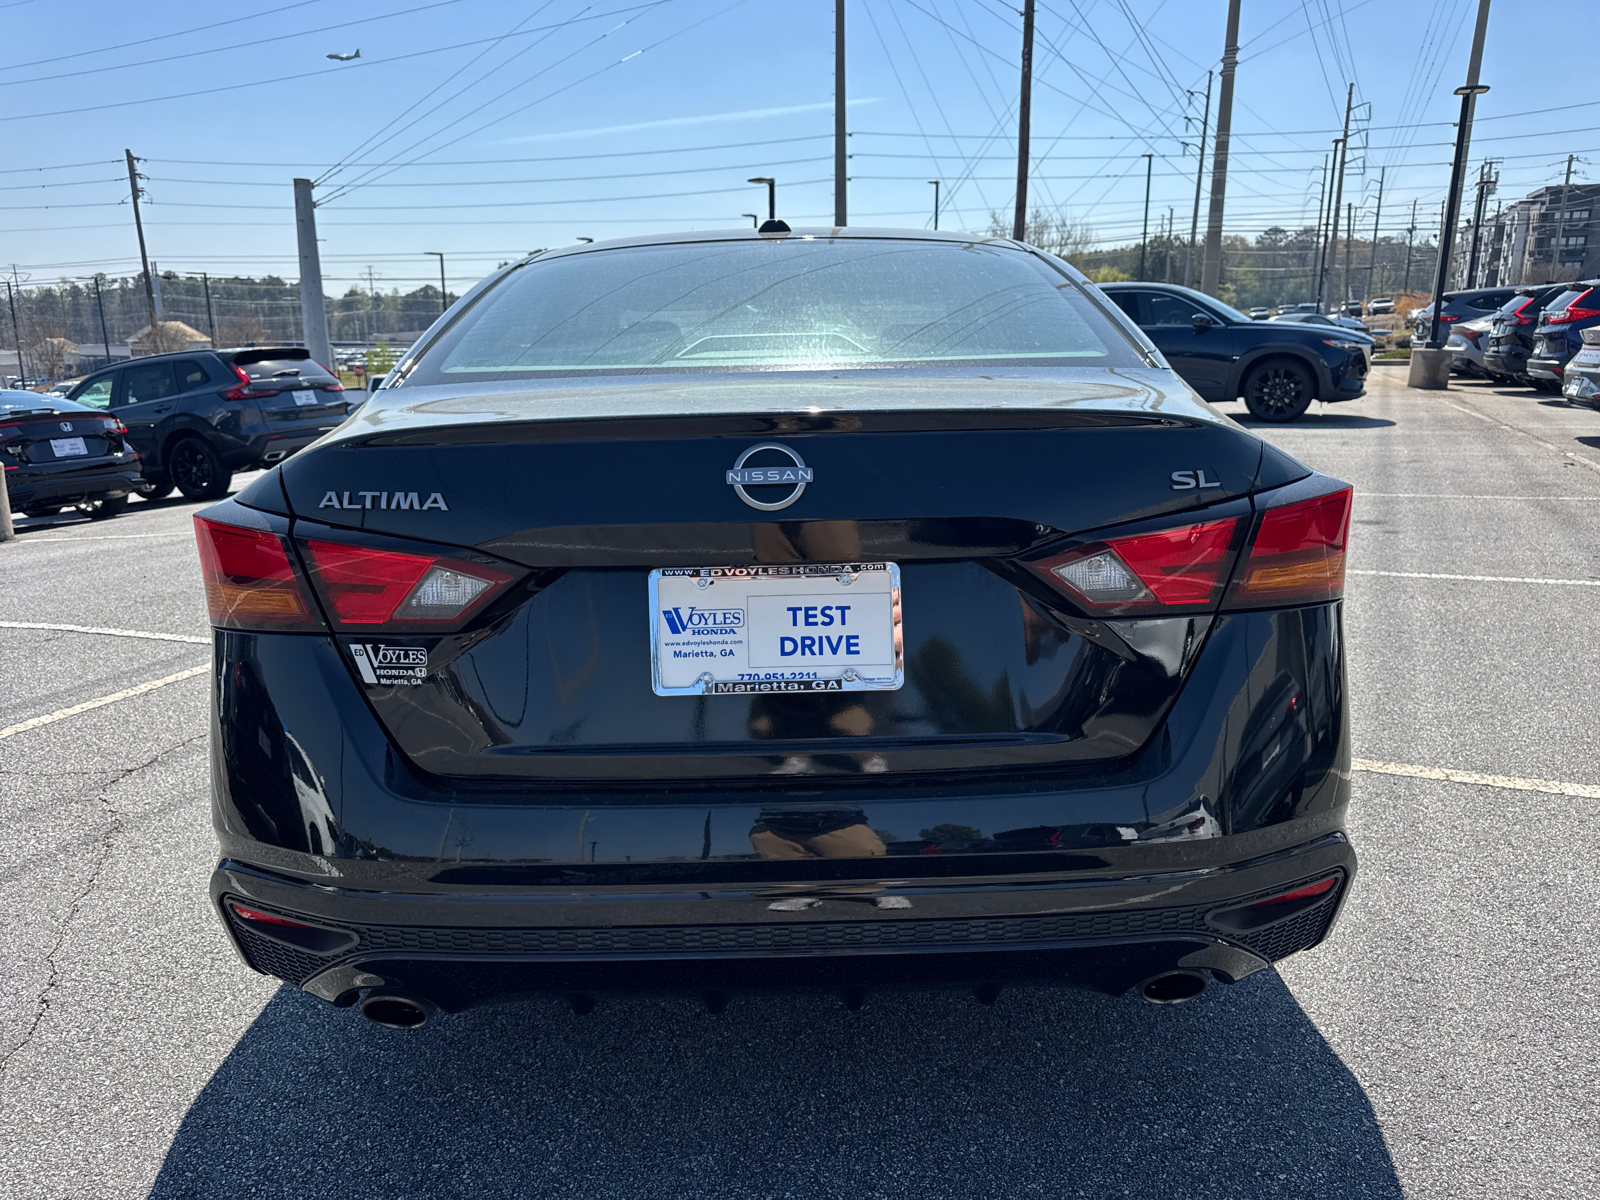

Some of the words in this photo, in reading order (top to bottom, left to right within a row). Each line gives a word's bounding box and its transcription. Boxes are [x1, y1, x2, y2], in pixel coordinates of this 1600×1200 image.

[729, 470, 811, 482] NISSAN
[1171, 470, 1221, 489] SL
[318, 491, 450, 511] ALTIMA
[672, 606, 741, 632] VOYLES
[786, 605, 851, 627] TEST
[673, 649, 717, 658] Marietta,
[719, 648, 735, 657] GA
[779, 634, 861, 657] DRIVE
[365, 644, 425, 667] VOYLES
[380, 678, 411, 686] Marietta,
[737, 671, 818, 681] 770-951-2211
[717, 681, 804, 692] Marietta,
[811, 680, 840, 690] GA
